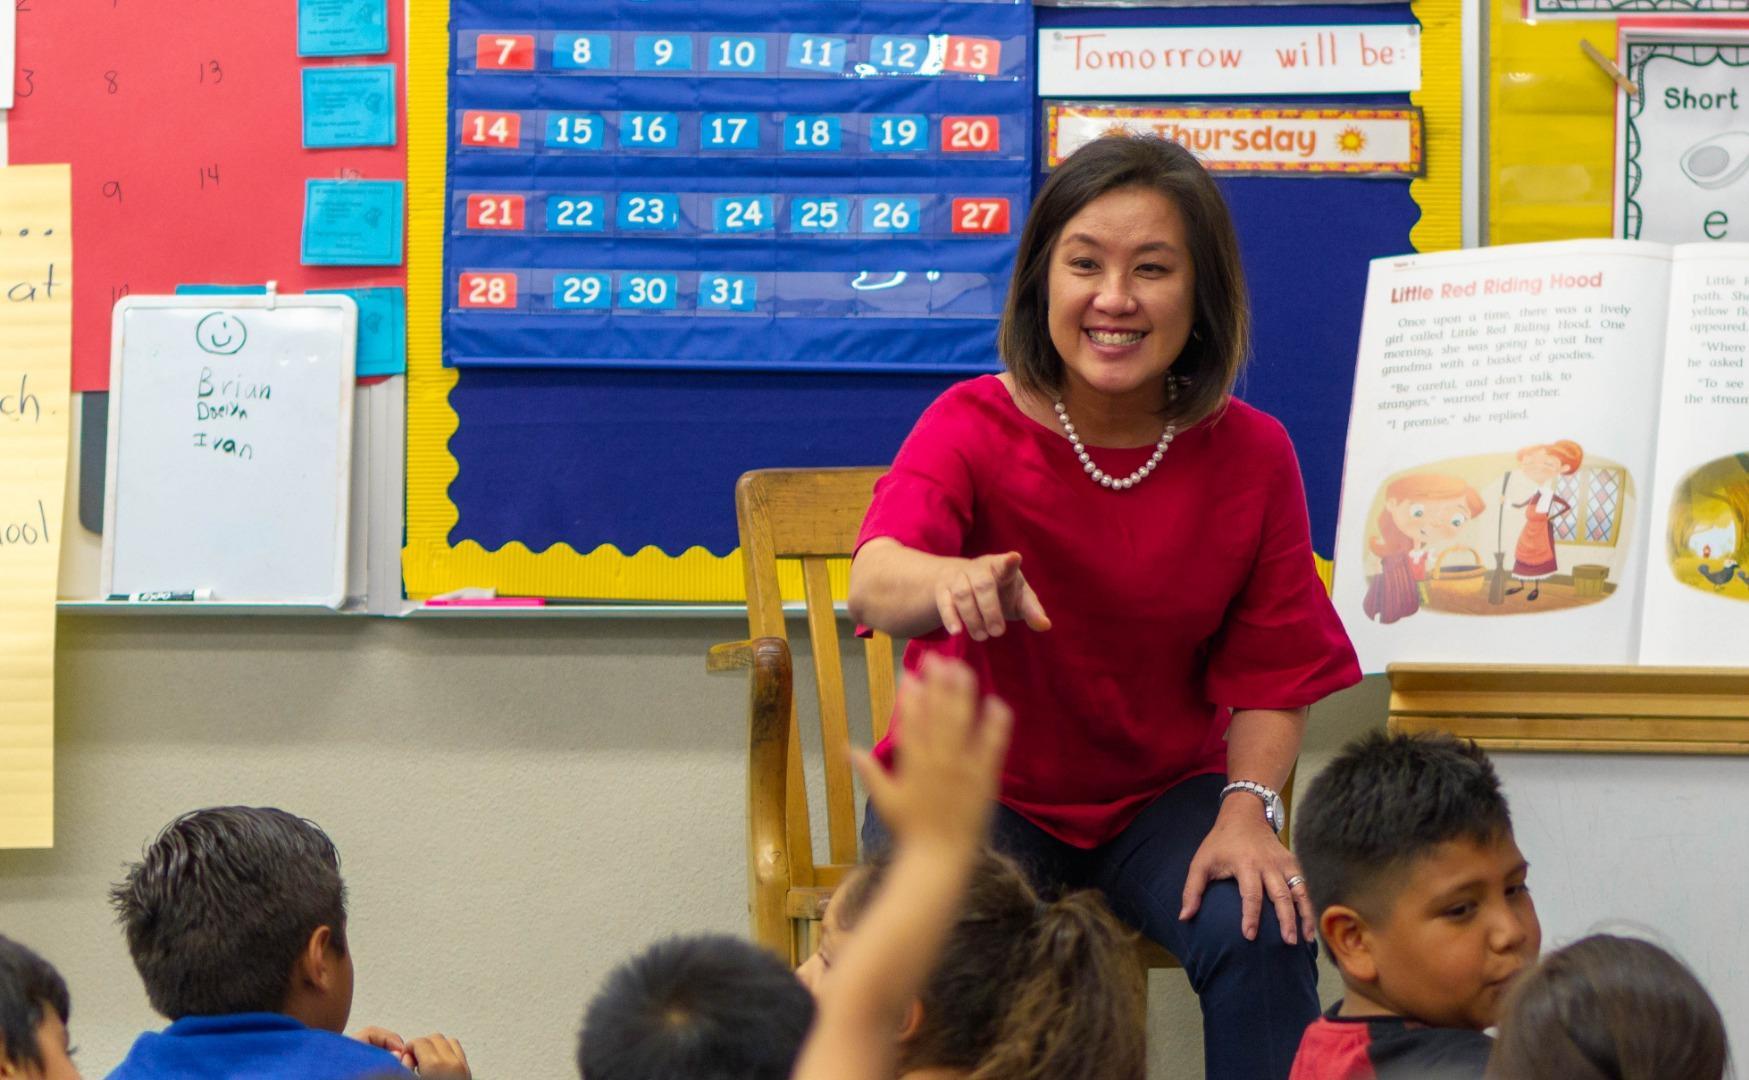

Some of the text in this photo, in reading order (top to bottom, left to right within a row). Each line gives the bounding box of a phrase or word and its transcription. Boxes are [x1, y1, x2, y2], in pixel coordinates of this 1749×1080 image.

[495, 38, 989, 71] 7 8 9 10 11 12 13
[1063, 31, 1406, 71] Tomorrow will be:
[16, 60, 223, 98] 3 8 13
[1663, 86, 1739, 111] Short
[473, 116, 989, 147] 14 15 16 17 18 19 20
[1152, 124, 1316, 157] Thursday
[199, 163, 220, 190] 14
[479, 197, 999, 228] 21 22 23 24 25 26 27
[1703, 210, 1728, 240] e
[8, 263, 60, 302] at
[469, 277, 743, 305] 28 29 30 31
[1391, 271, 1603, 304] Little Red Riding Hood
[1706, 274, 1736, 287] Little
[1398, 317, 1426, 329] Once
[1433, 315, 1462, 327] upon
[1520, 307, 1548, 318] there
[1554, 304, 1577, 314] was
[1600, 303, 1631, 316] lively
[1691, 305, 1729, 319] yellow
[1385, 318, 1626, 346] girl called Little Red Riding Hood. One
[1441, 344, 1461, 355] she
[1467, 342, 1489, 353] was
[1495, 338, 1528, 351] going
[1535, 337, 1547, 346] to
[1553, 334, 1577, 345] visit
[1584, 333, 1604, 344] her
[1382, 361, 1433, 377] grandma
[1440, 358, 1465, 370] with
[1487, 353, 1522, 366] basket
[1529, 350, 1543, 361] of
[1547, 349, 1595, 363] goodies.
[1688, 356, 1744, 368] he asked
[198, 366, 271, 400] Brian
[1465, 375, 1489, 388] and
[1531, 370, 1553, 383] talk
[1561, 371, 1573, 381] to
[1725, 380, 1744, 389] see
[1442, 391, 1485, 404] warned
[1492, 391, 1512, 402] her
[1684, 393, 1704, 404] the
[1463, 411, 1482, 424] she
[192, 431, 253, 461] Ivan
[0, 499, 49, 546] ool
